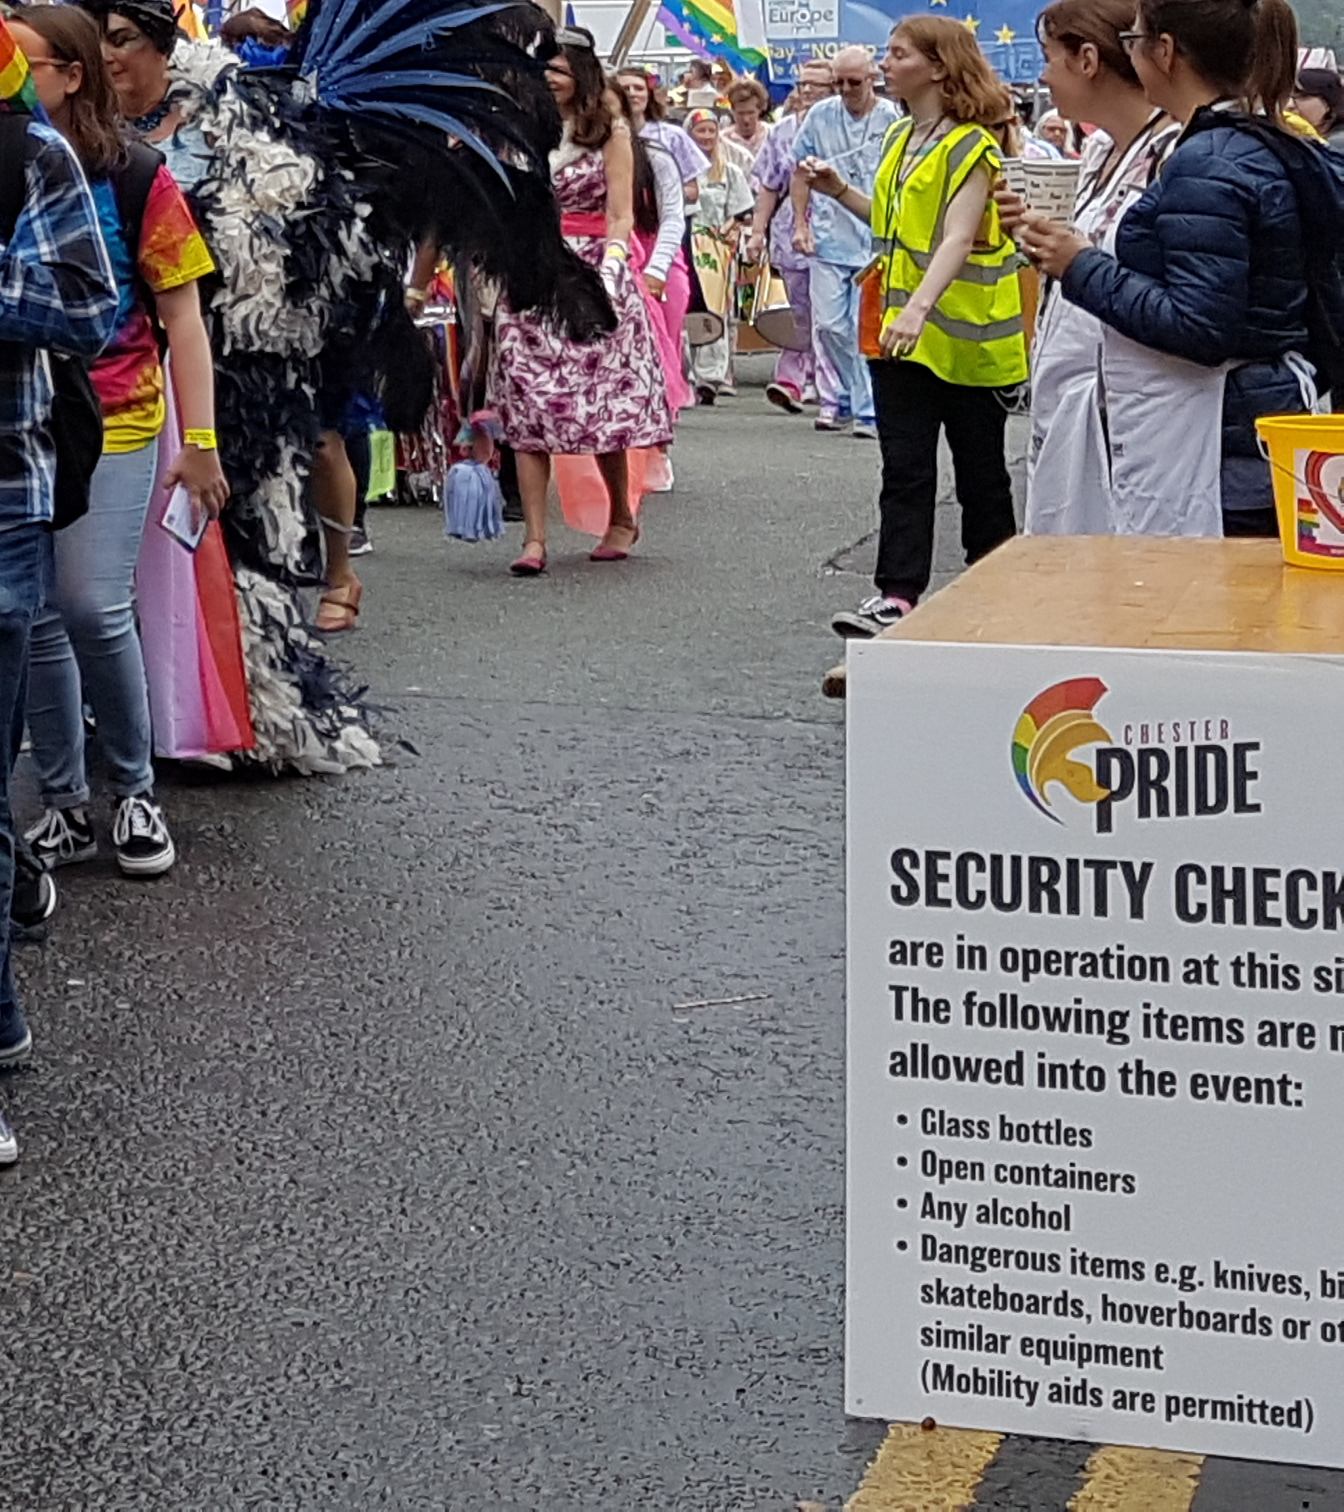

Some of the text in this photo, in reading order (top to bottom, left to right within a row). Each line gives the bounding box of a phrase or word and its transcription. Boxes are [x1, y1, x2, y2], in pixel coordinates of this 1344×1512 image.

[769, 6, 834, 24] Europe
[1124, 719, 1231, 745] CHESTER
[1096, 742, 1262, 834] PRIDE
[889, 848, 1344, 930] SECURITY CHECK
[888, 938, 944, 969] are
[956, 933, 987, 971] in
[1000, 943, 1170, 982] operation
[1182, 953, 1219, 986] at
[1230, 951, 1301, 991] this
[888, 985, 952, 1024] The
[963, 990, 1129, 1045] following
[1141, 1002, 1244, 1045] items
[1257, 1019, 1316, 1049] are
[888, 1044, 1304, 1108] allowed into the event:
[921, 1107, 1093, 1148] Glass bottles
[921, 1149, 1136, 1194] Open containers
[921, 1192, 1071, 1231] Any alcohol
[921, 1234, 1061, 1273] Dangerous
[1070, 1247, 1146, 1281] items
[1154, 1261, 1205, 1292] e.g.
[1213, 1261, 1311, 1300] knives,
[921, 1278, 1092, 1323] skateboards,
[1101, 1293, 1272, 1337] hoverboards
[1282, 1315, 1311, 1341] or
[921, 1322, 1165, 1371] similar equipment
[921, 1360, 1314, 1433] (Mobility aids are permitted)
